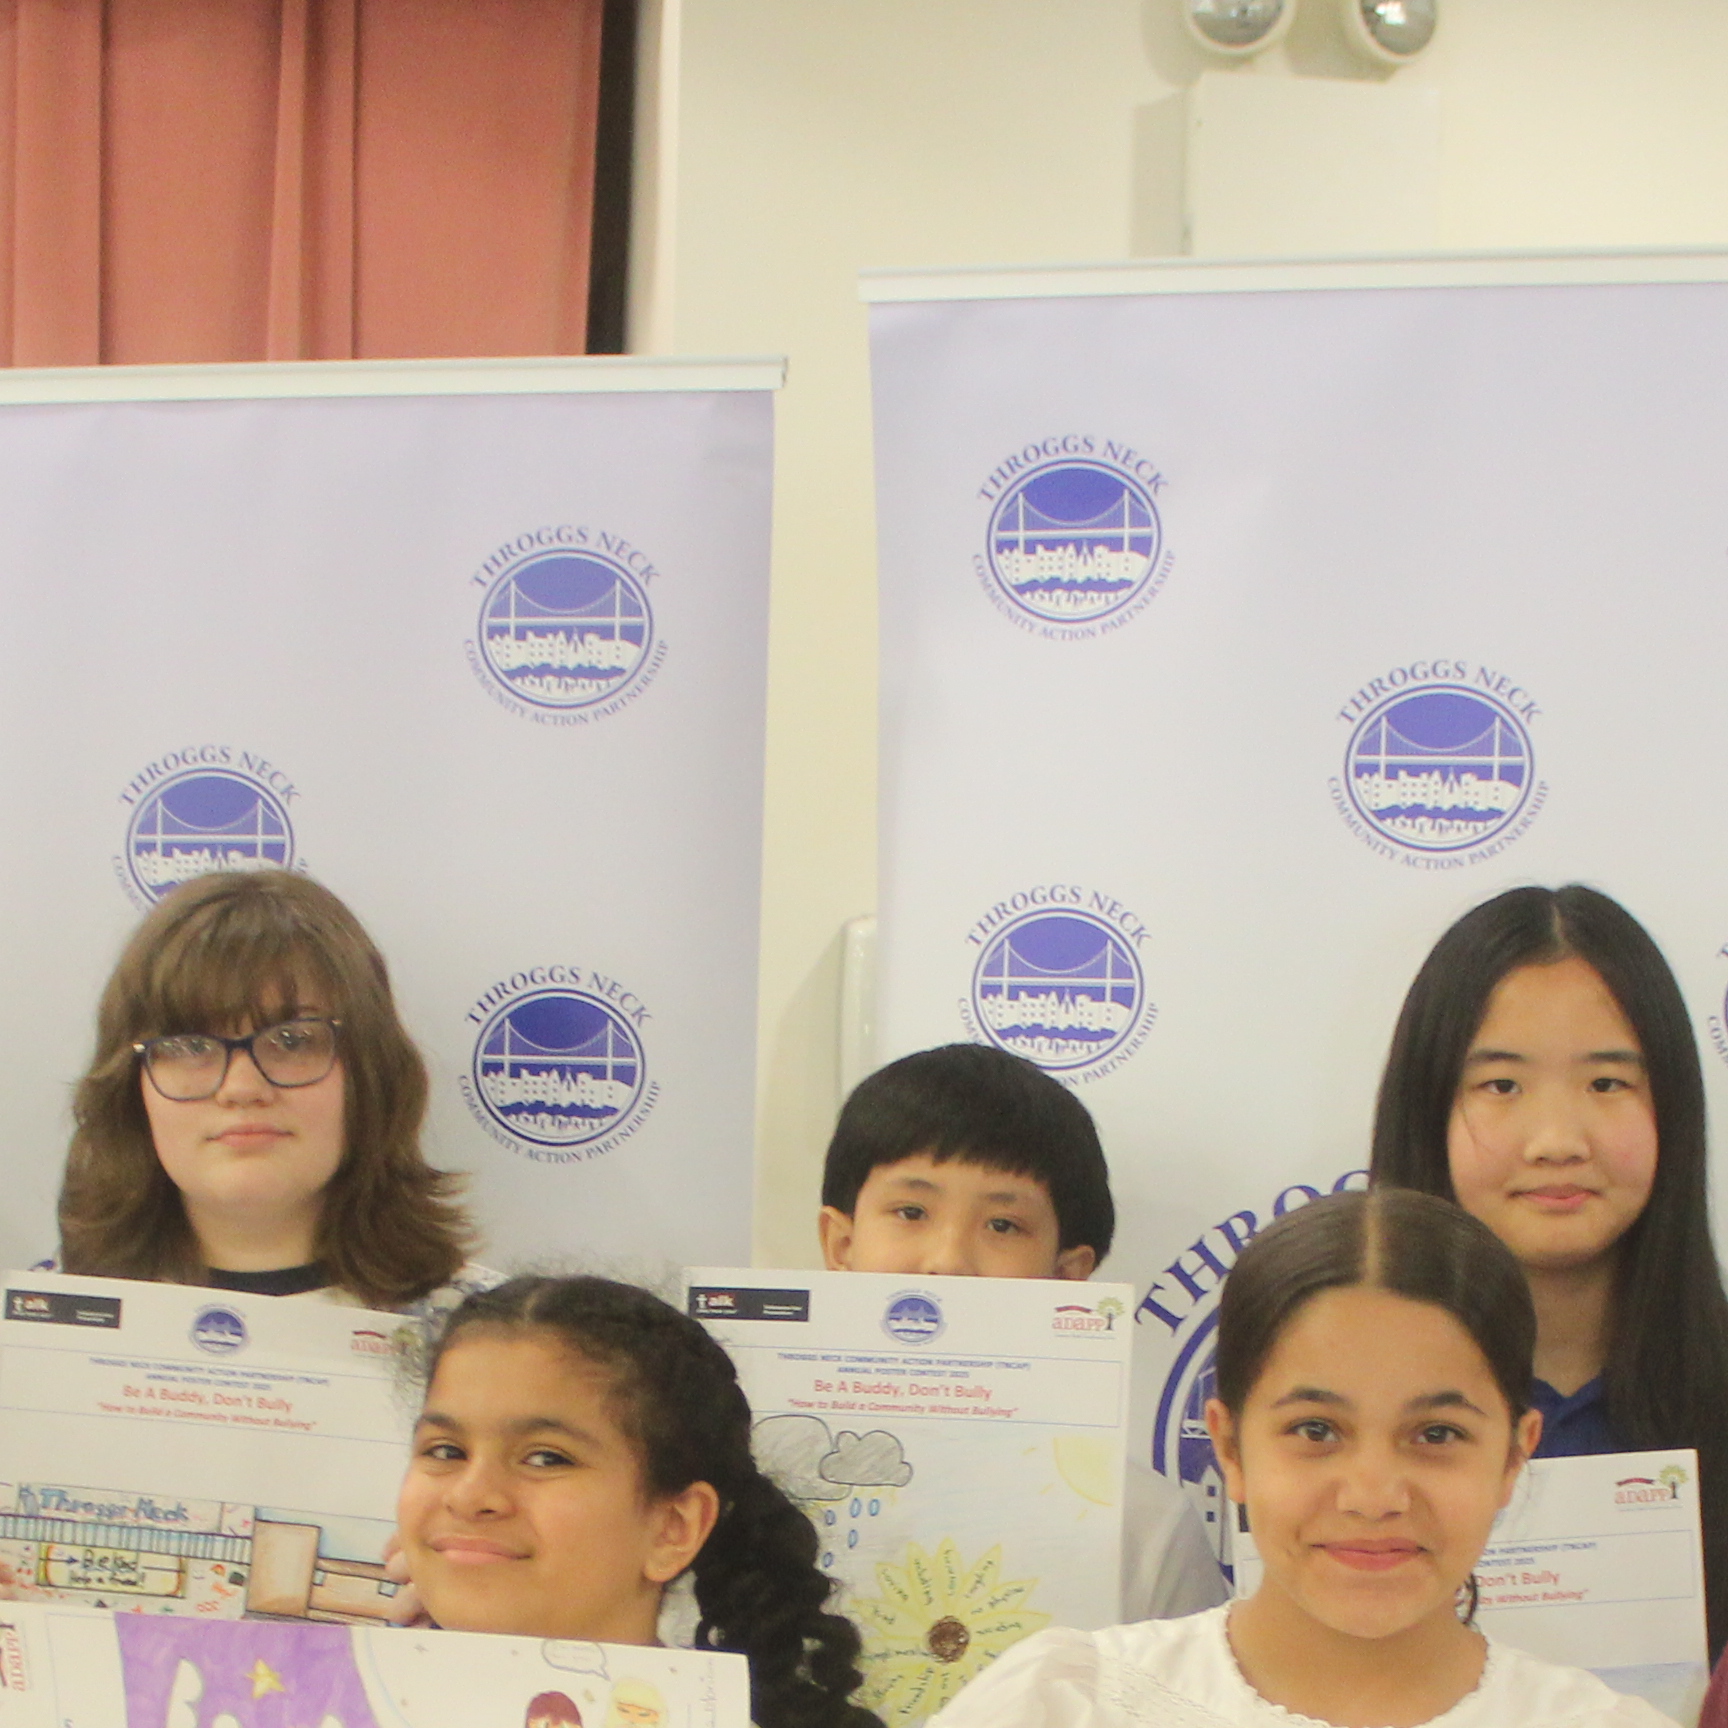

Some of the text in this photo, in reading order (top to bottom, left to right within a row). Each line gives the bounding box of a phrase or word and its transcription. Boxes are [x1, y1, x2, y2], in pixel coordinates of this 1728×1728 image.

[979, 437, 1169, 501] THROGGS NECK
[472, 526, 662, 589] THROGGS NECK
[973, 550, 1175, 640] COMMUNITY ACTION PARTNERSHIP
[464, 639, 666, 725] COMMUNITY ACTION PARTNERSHIP
[1339, 660, 1545, 727] THROGGS NECK
[121, 746, 302, 807] THROGGS NECK
[1329, 778, 1547, 869] COMMUNITY ACTION PARTNERSHIP
[968, 885, 1153, 950] THROGGS NECK
[466, 966, 653, 1029] THROGGS NECK
[459, 1076, 658, 1162] COMMUNITY ACTION PARTNERSHIP
[813, 1379, 833, 1392] Be
[836, 1380, 848, 1393] A
[954, 1385, 991, 1401] Bully
[1523, 1569, 1560, 1586] Bully
